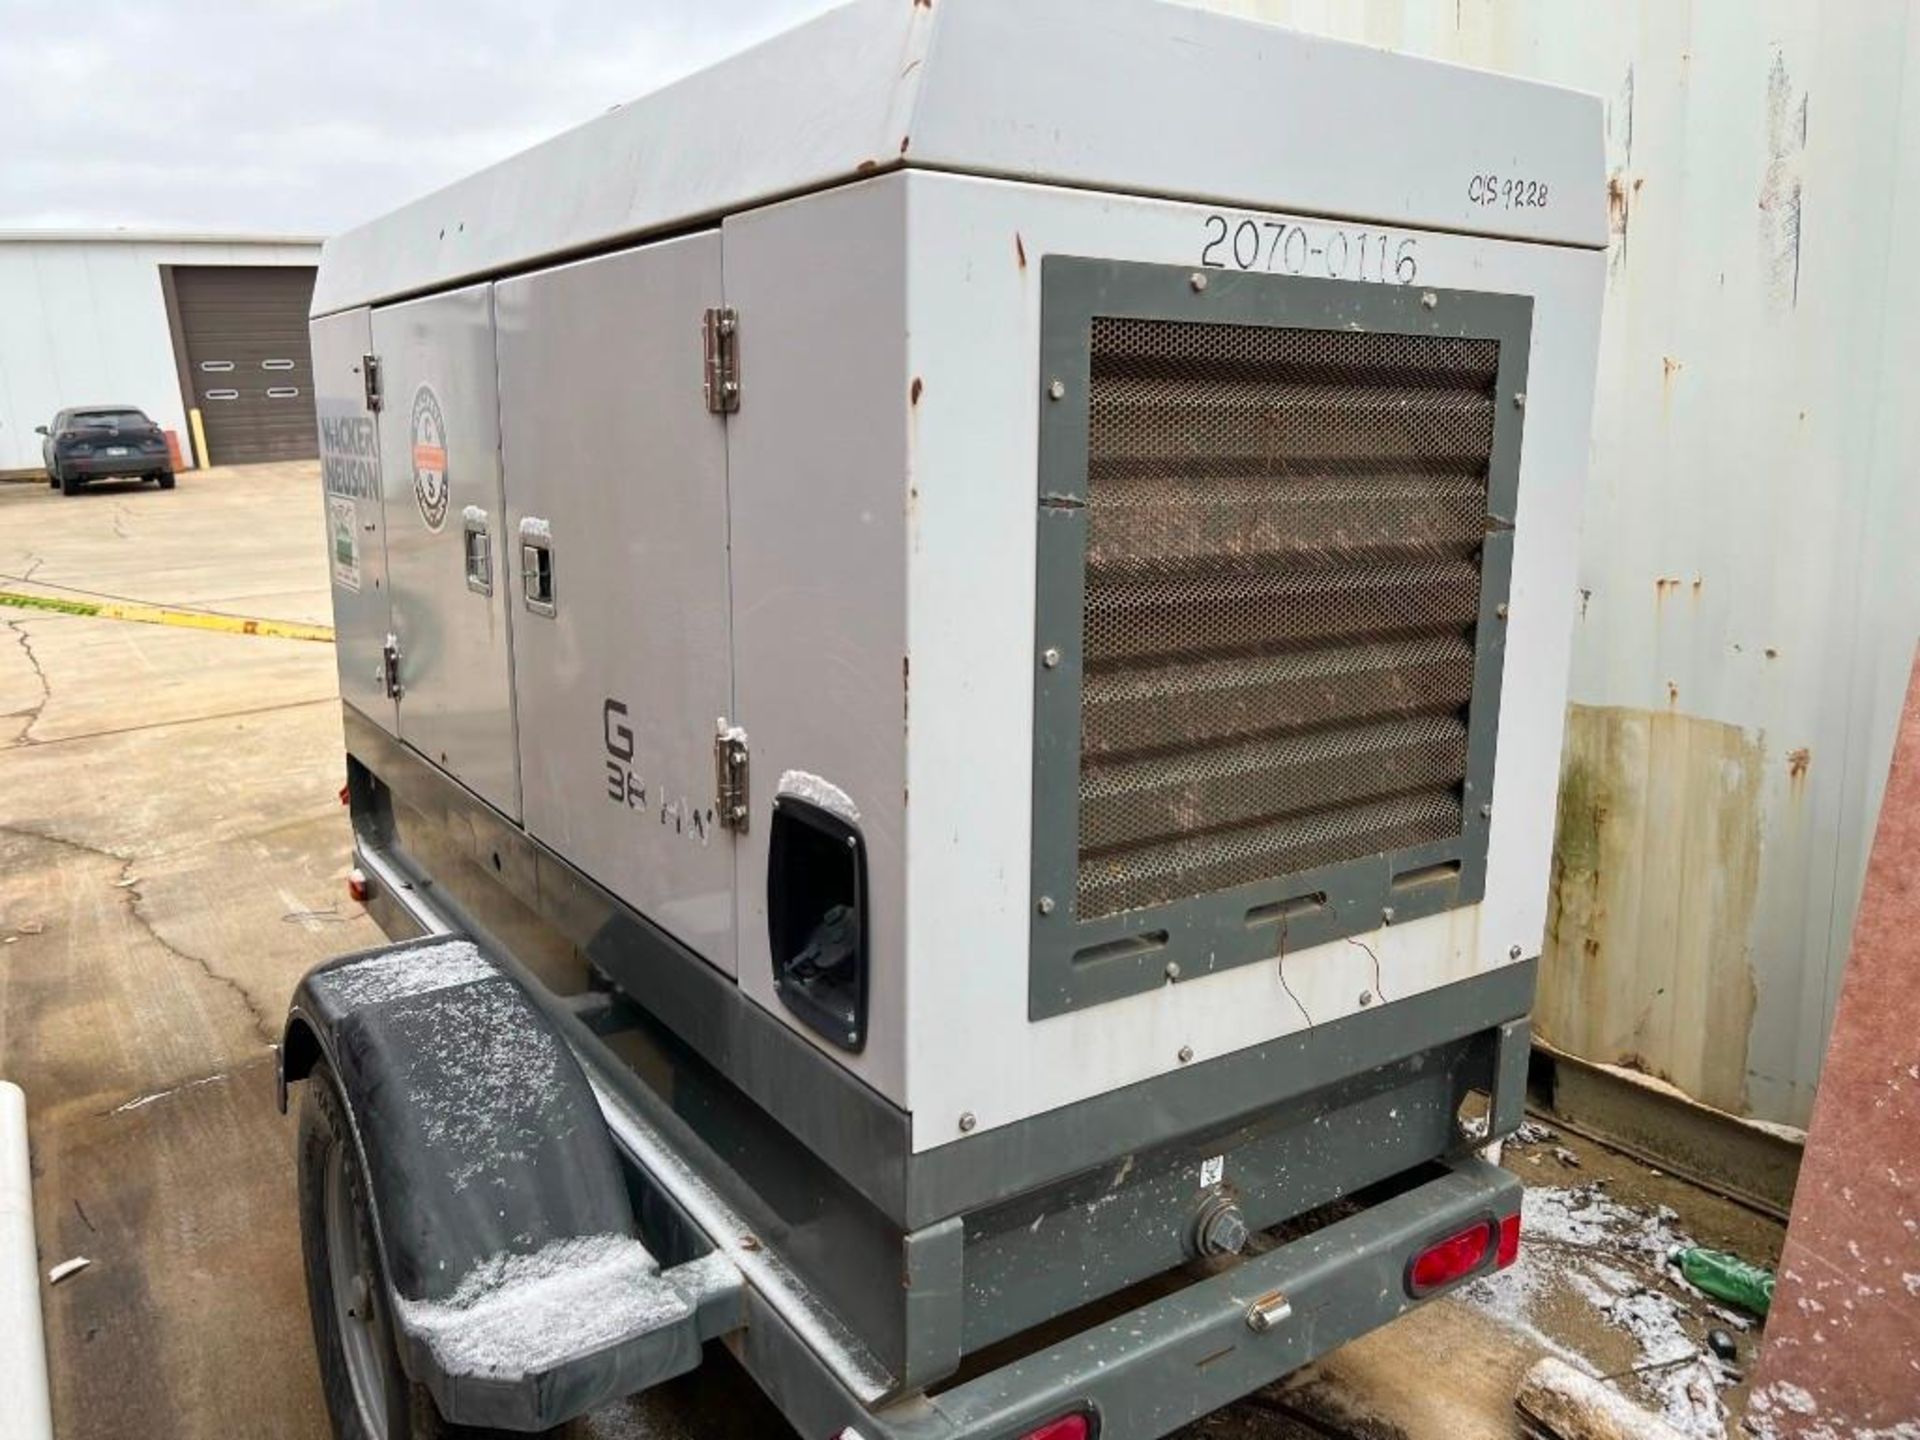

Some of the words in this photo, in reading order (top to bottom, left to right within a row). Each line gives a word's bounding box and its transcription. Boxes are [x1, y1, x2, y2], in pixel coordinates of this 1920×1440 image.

[1502, 178, 1549, 210] 9228
[1201, 214, 1418, 285] 2070-0116
[326, 457, 379, 502] NEUSON
[604, 698, 634, 764] G
